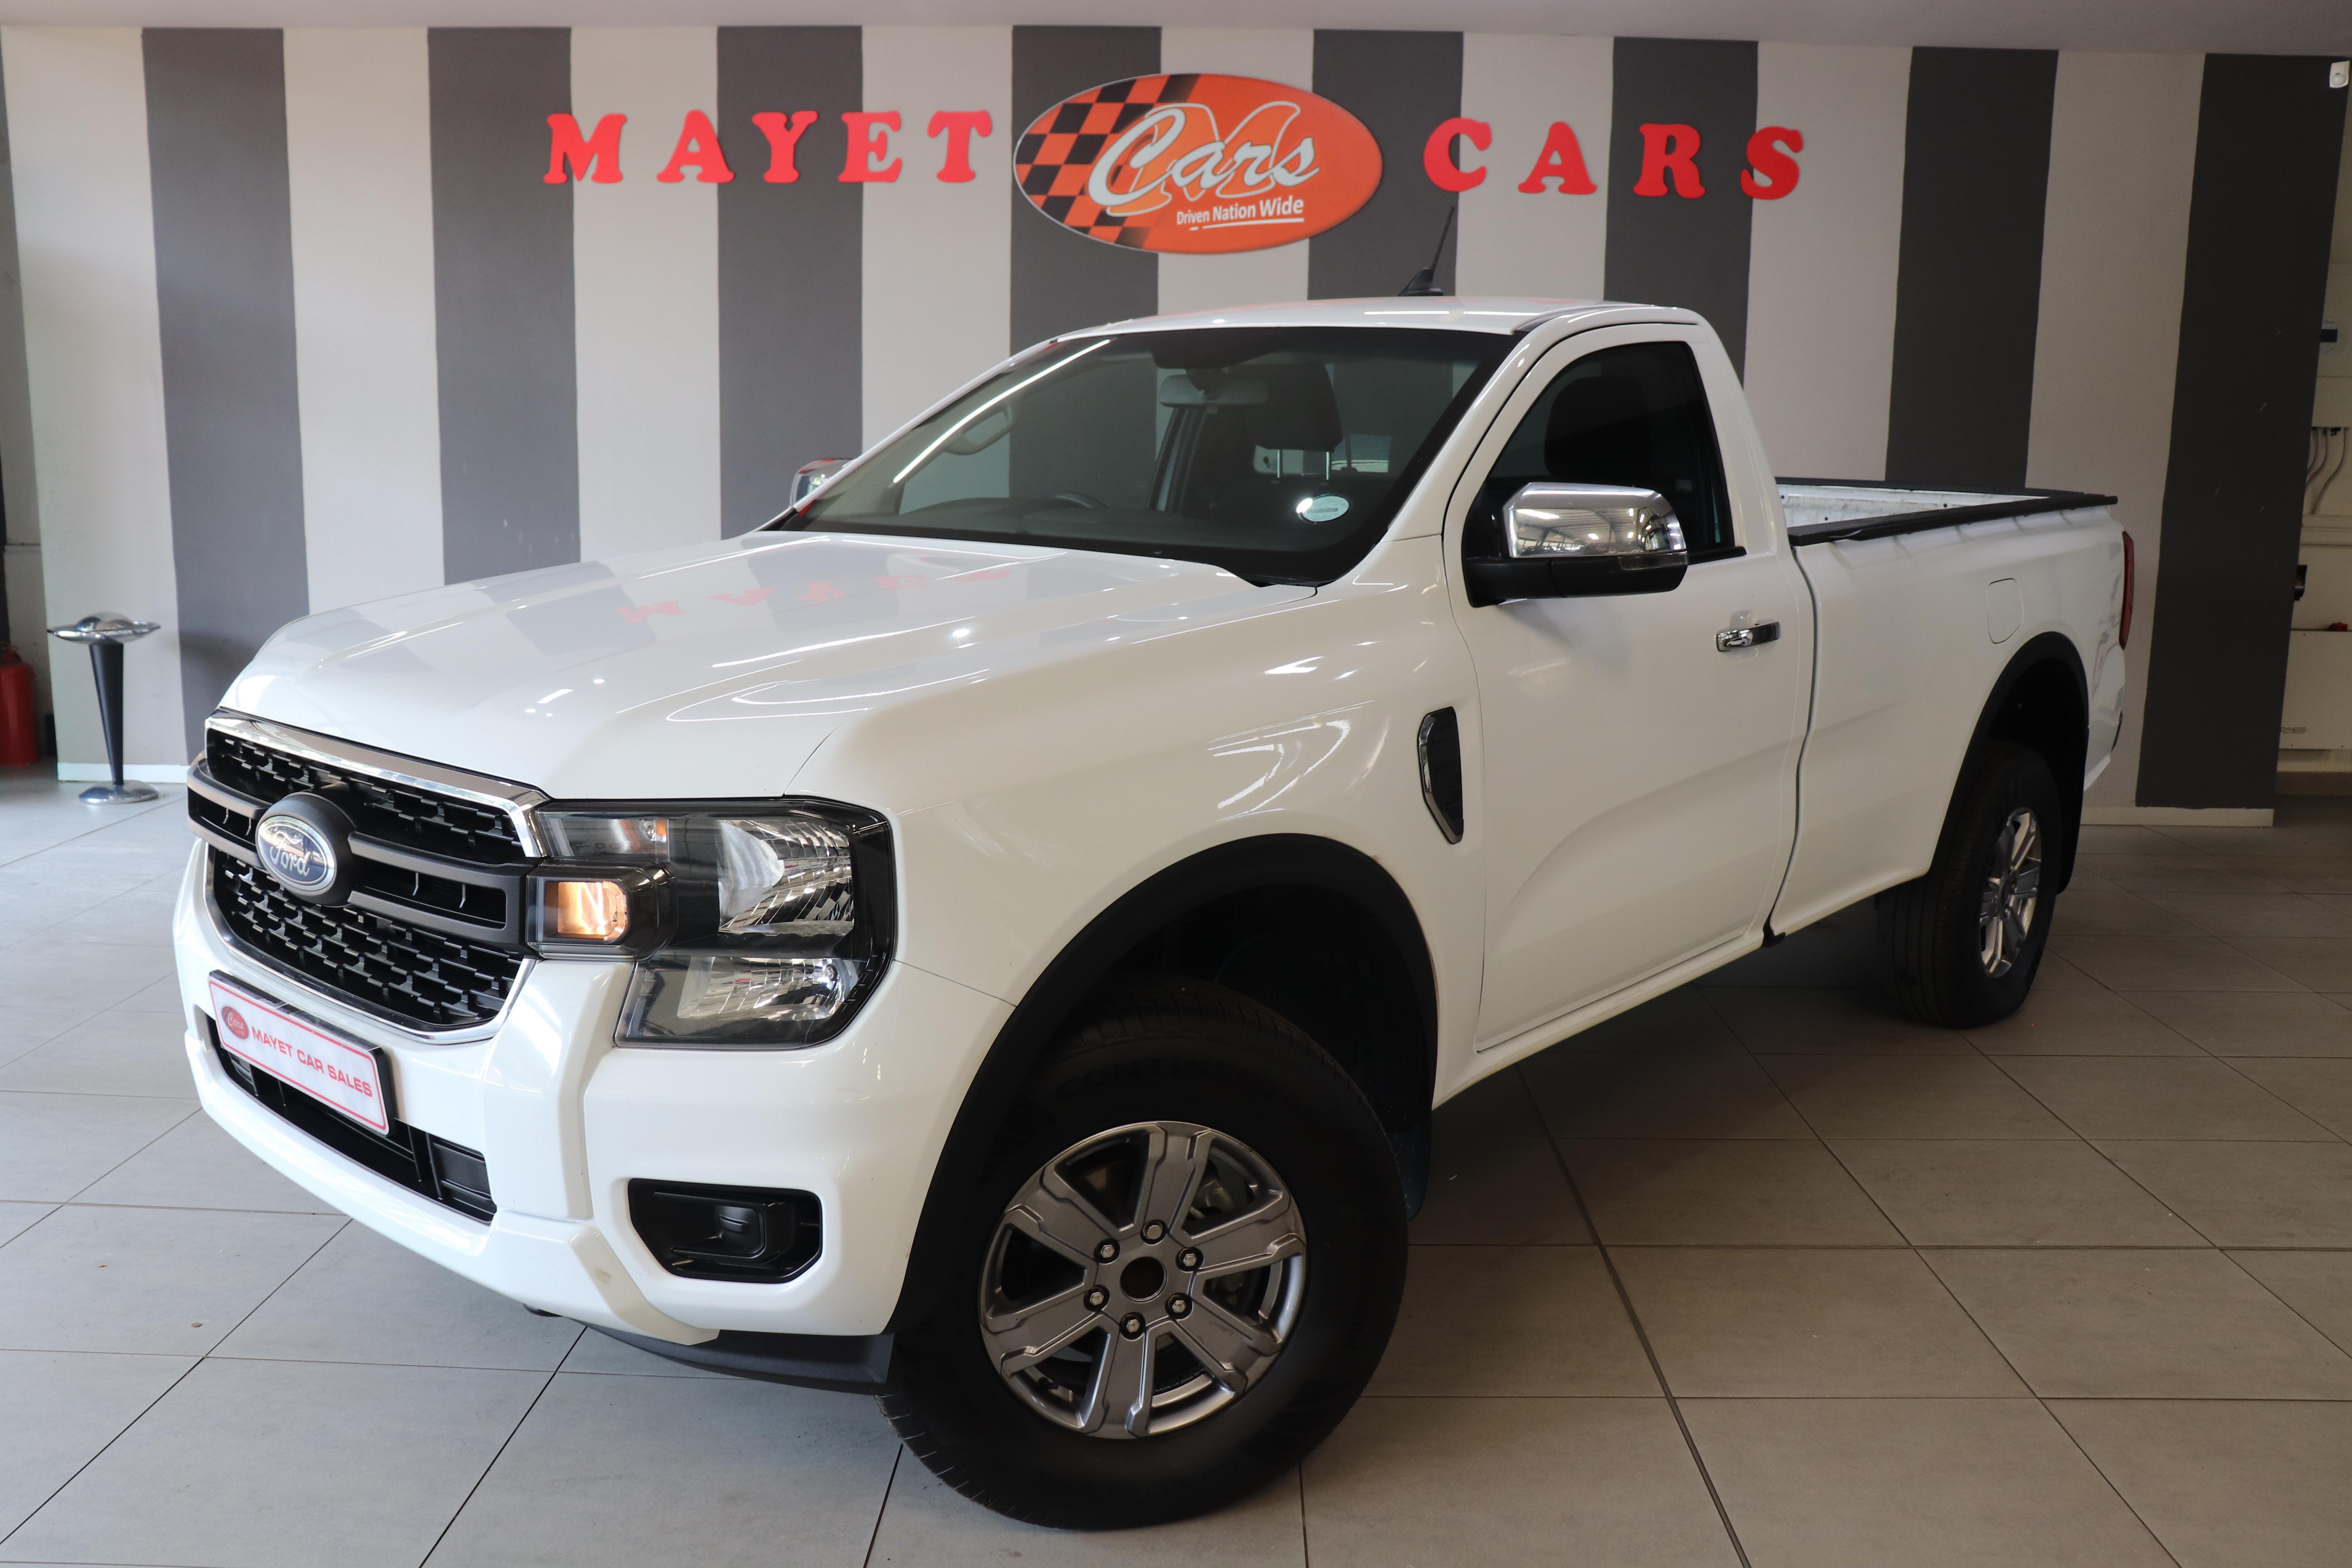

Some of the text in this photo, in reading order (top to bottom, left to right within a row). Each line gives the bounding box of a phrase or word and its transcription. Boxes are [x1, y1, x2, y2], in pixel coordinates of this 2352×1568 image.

[543, 109, 1803, 200] MAYET CARS
[1088, 107, 1319, 206] Cars
[1177, 195, 1304, 225] Driven Nation Wide
[252, 1026, 373, 1097] MAYET CAR SALES
